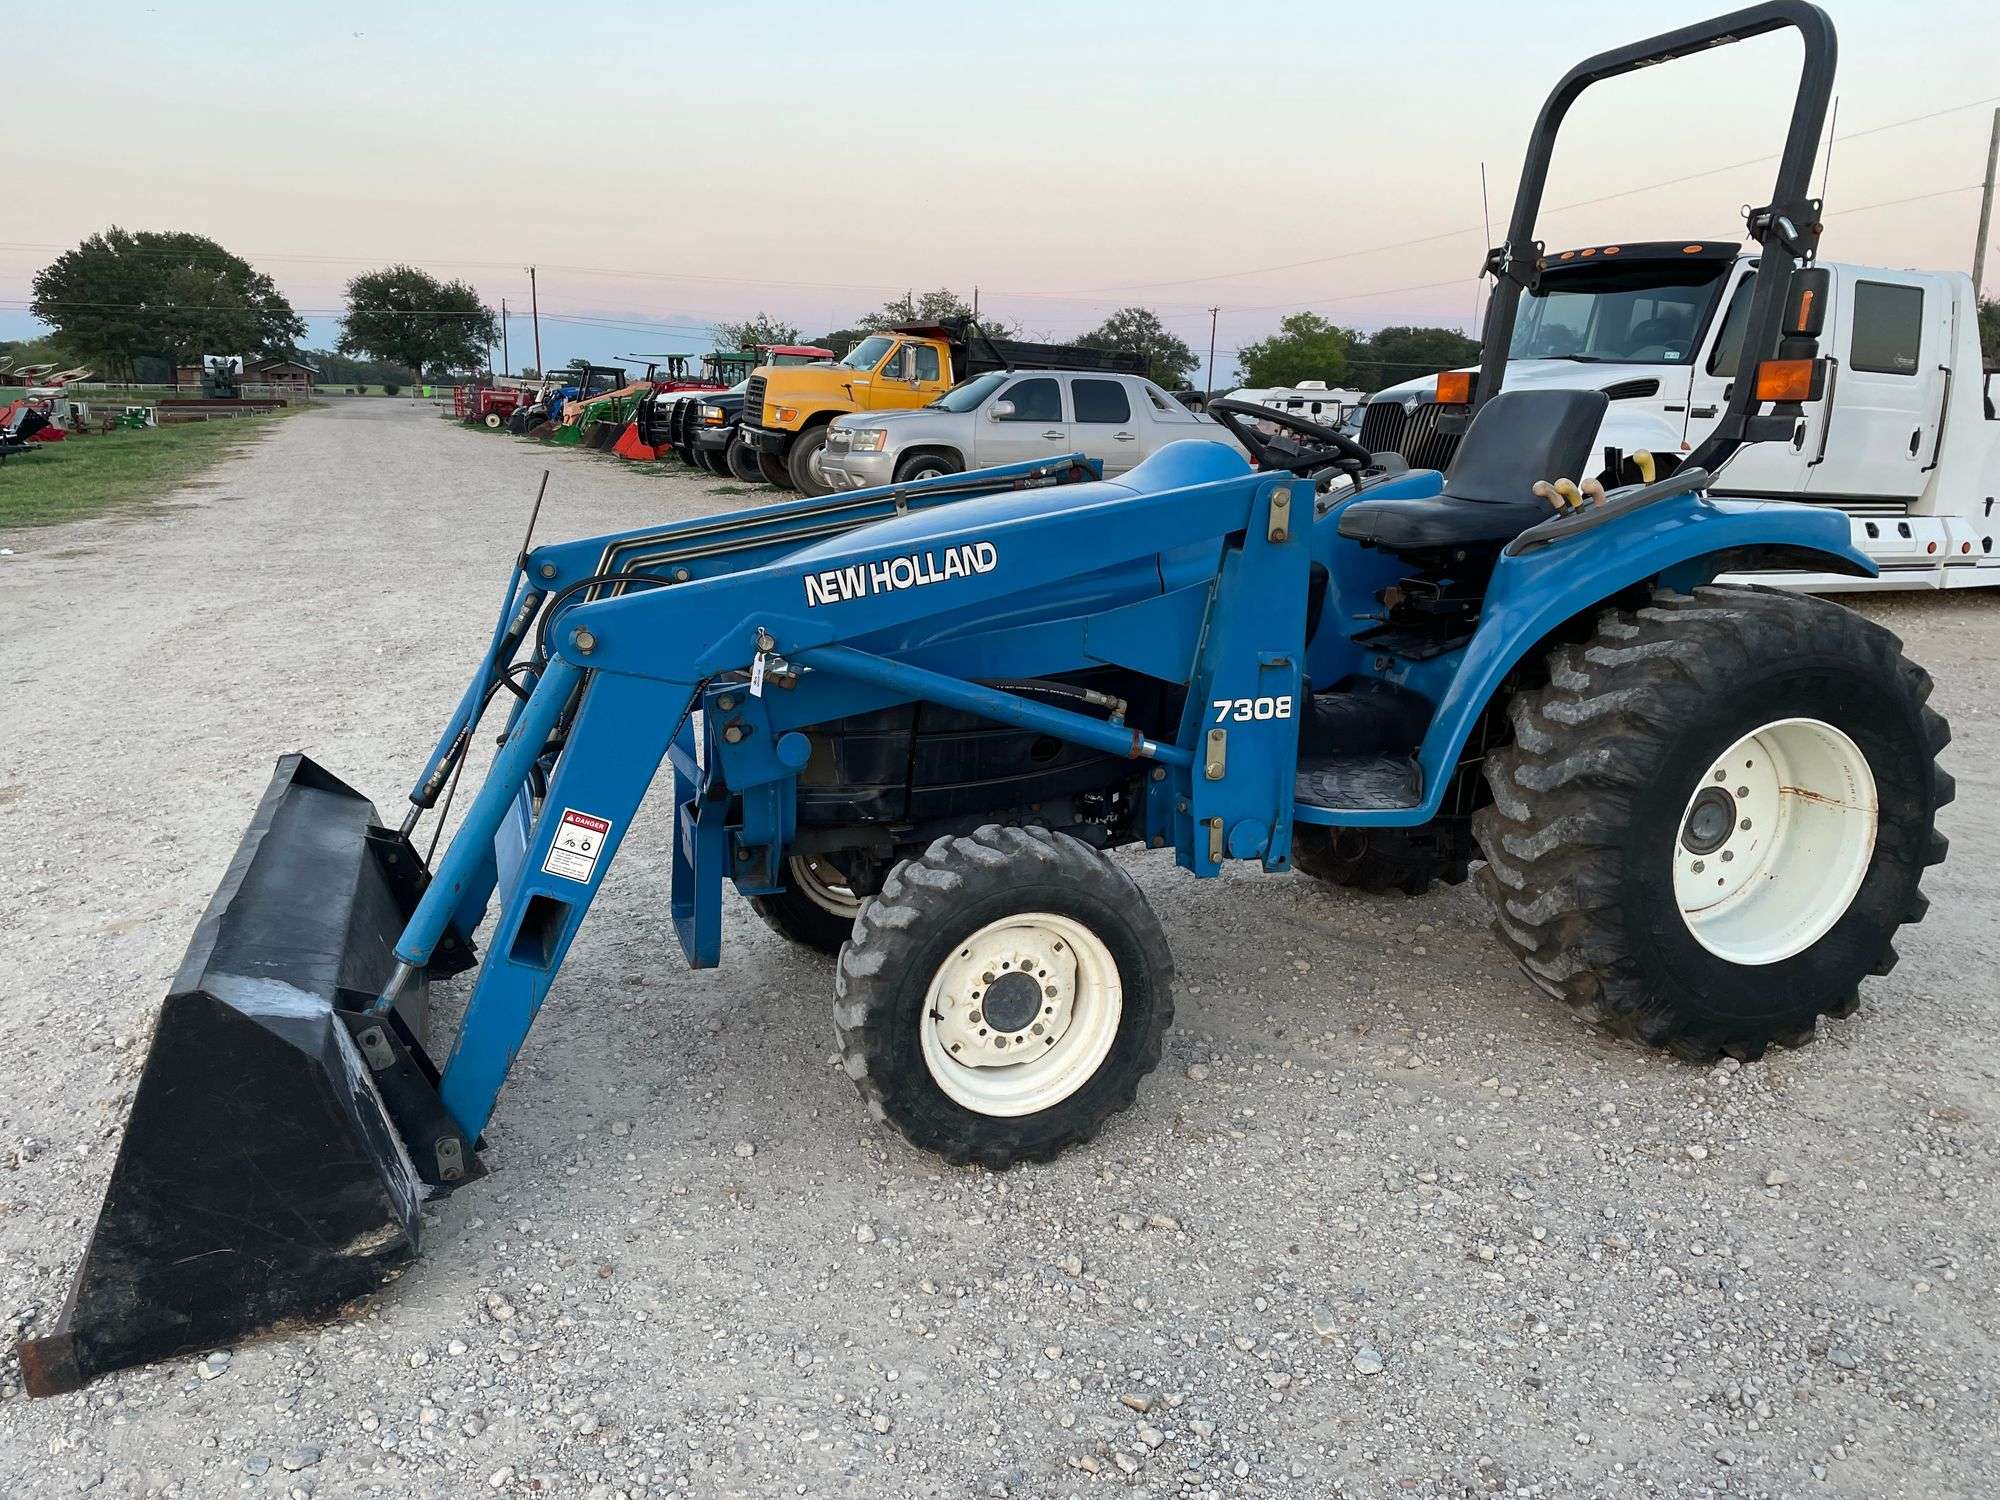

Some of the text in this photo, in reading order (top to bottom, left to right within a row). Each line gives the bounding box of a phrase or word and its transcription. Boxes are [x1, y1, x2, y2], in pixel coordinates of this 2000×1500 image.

[803, 541, 998, 607] NEW HOLLAND
[1213, 695, 1292, 723] 7308
[574, 816, 605, 830] DANGER
